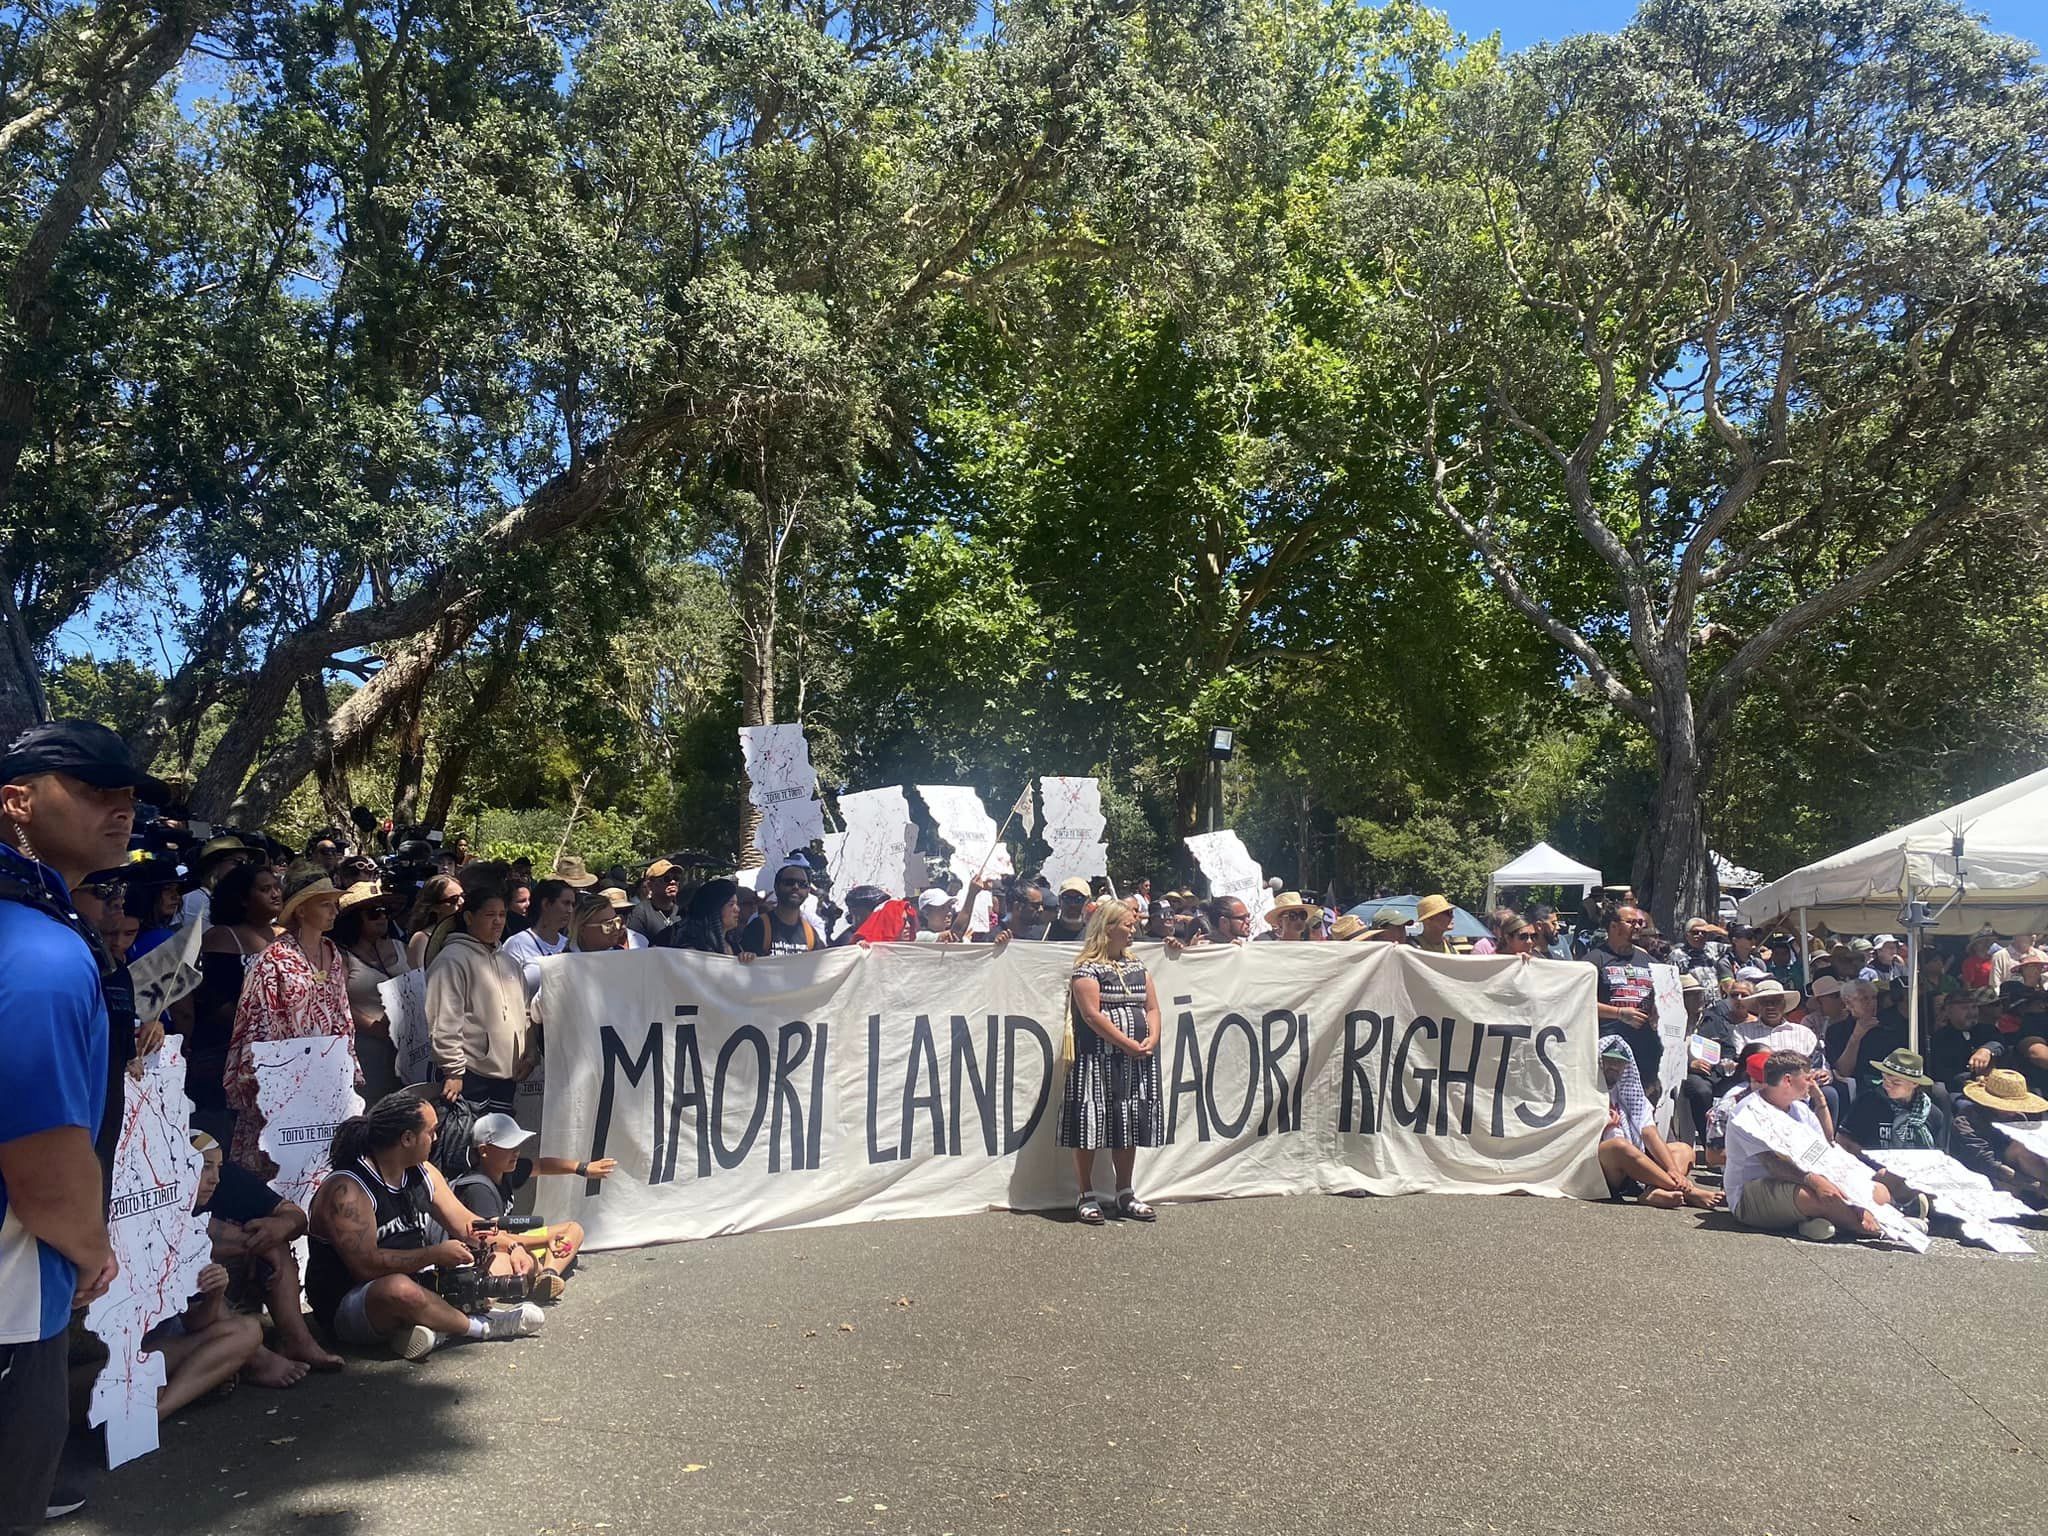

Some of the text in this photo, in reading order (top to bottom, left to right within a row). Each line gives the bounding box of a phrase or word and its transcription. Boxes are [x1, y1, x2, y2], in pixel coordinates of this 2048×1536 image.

[585, 994, 1567, 1197] MĀORI LAND ĀORI RIGHTS
[305, 1127, 315, 1140] TE
[317, 1126, 337, 1139] TIRIT
[140, 1191, 151, 1209] TE
